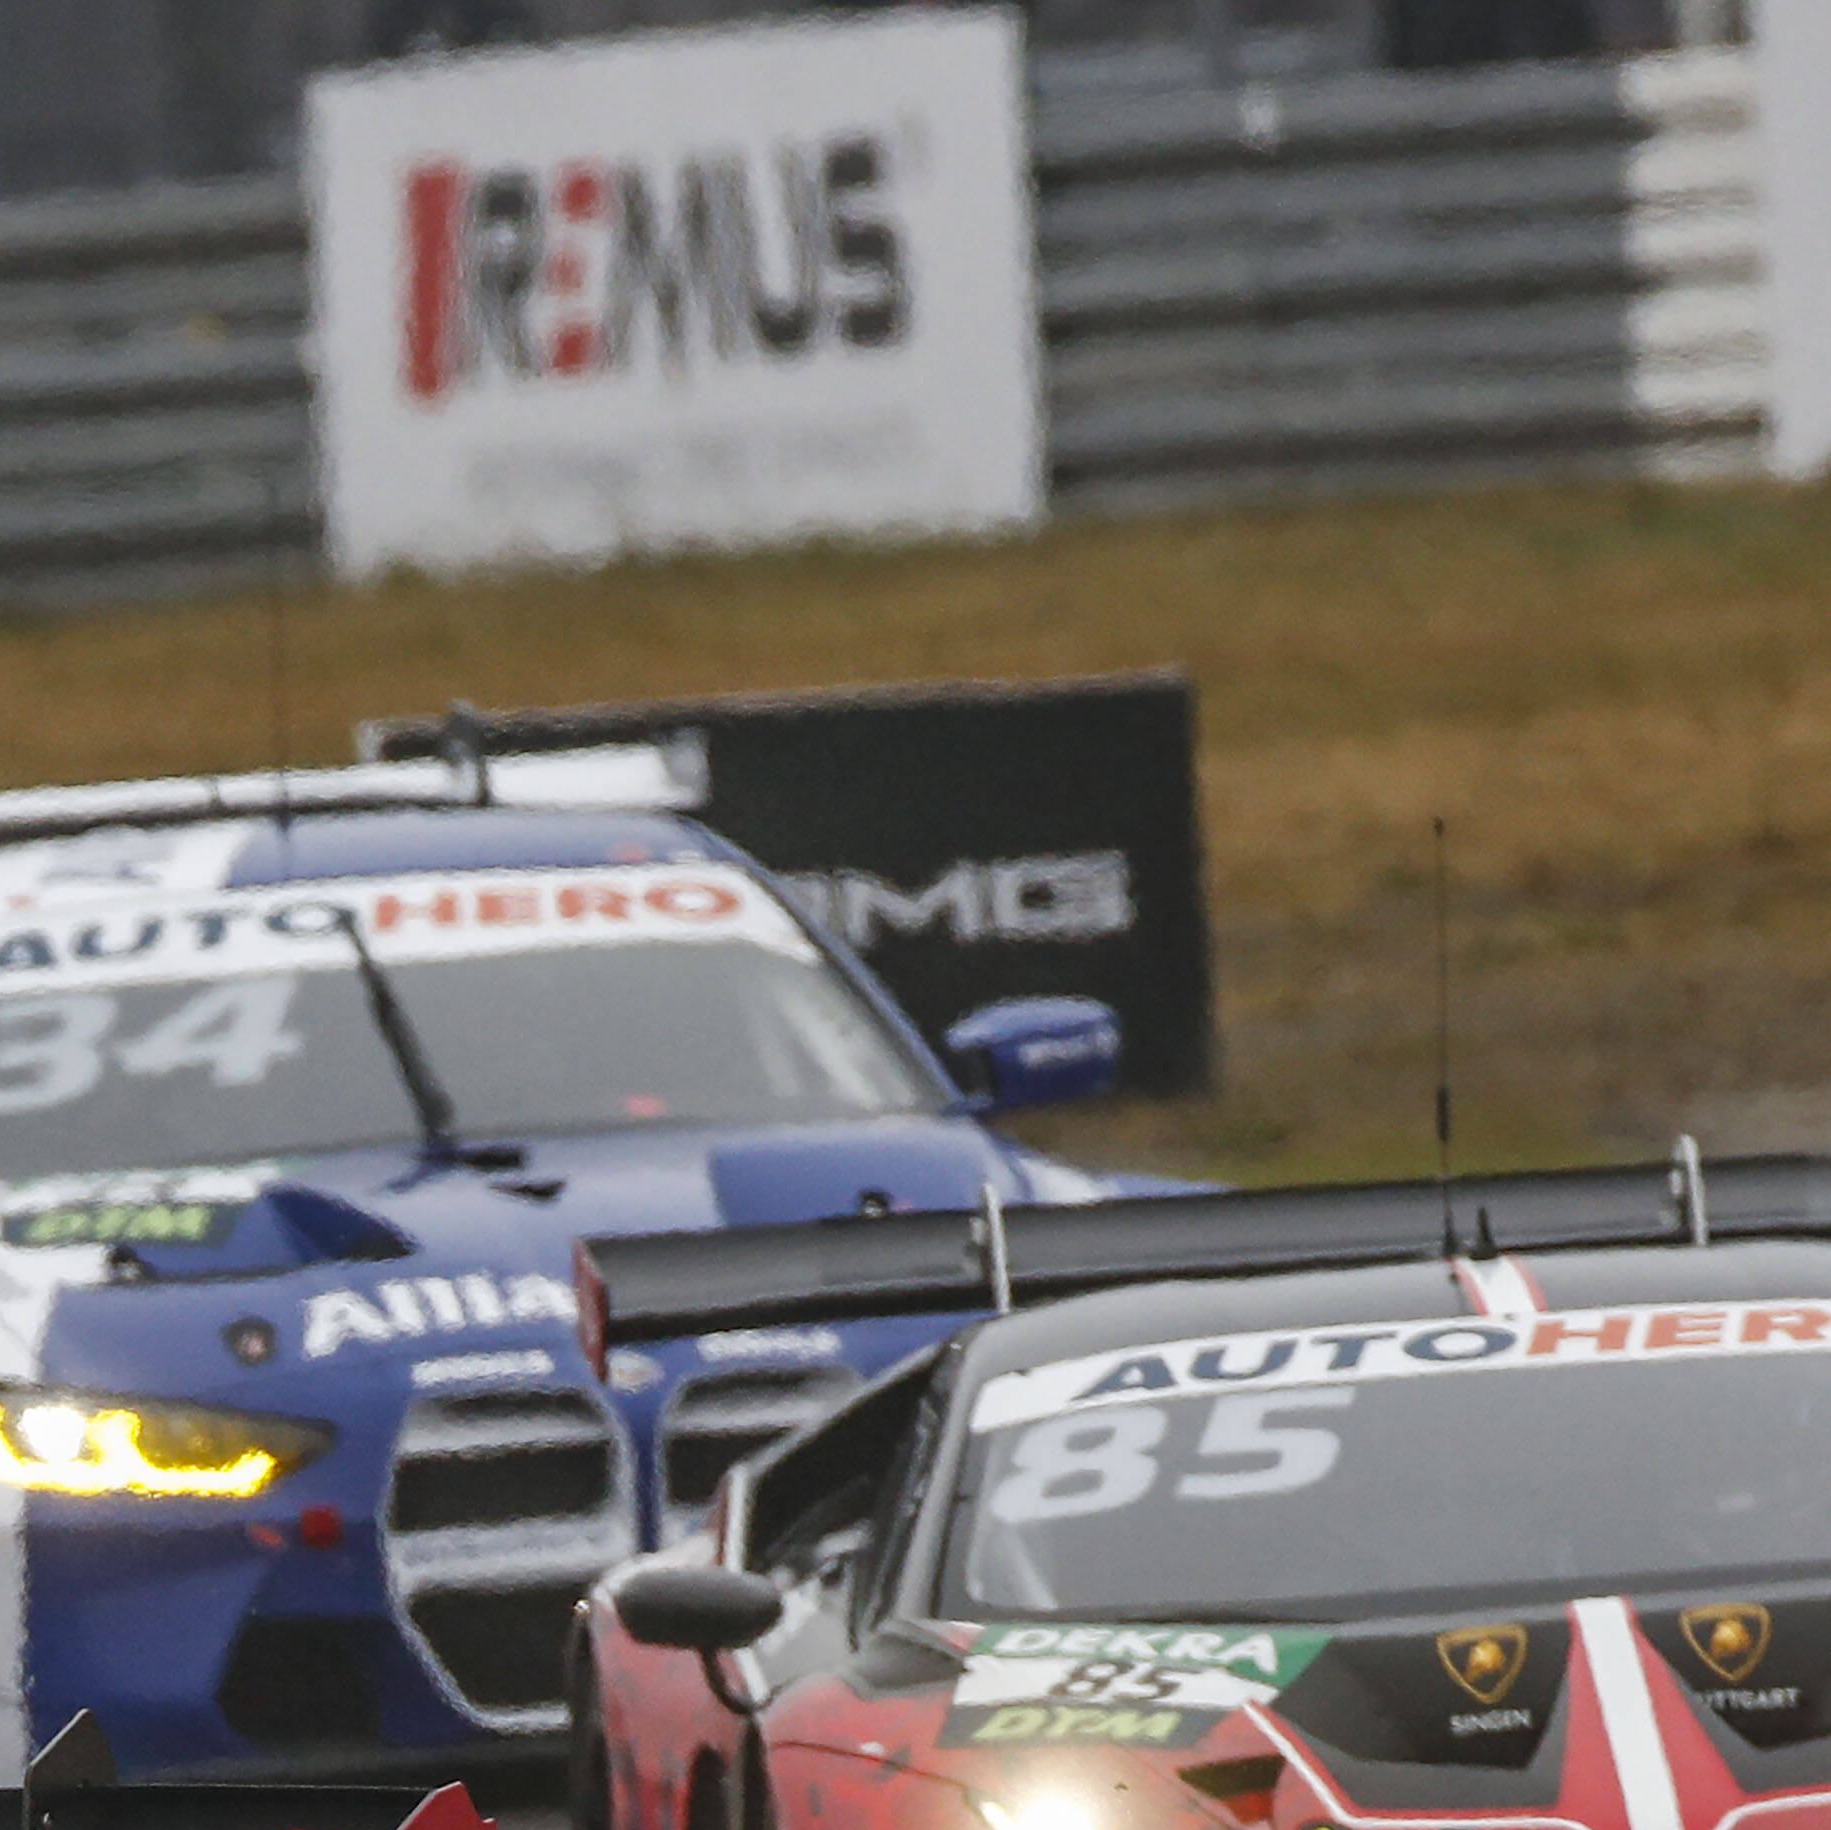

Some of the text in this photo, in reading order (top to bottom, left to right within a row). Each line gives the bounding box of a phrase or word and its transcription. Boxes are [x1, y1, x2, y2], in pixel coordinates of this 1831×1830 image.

[301, 1274, 577, 1357] Allia
[1078, 1307, 1831, 1400] AUTOHER
[990, 1386, 1357, 1526] 85
[994, 1624, 1281, 1683] DEKRA
[1045, 1656, 1181, 1705] 85
[971, 1705, 1184, 1743] DTM
